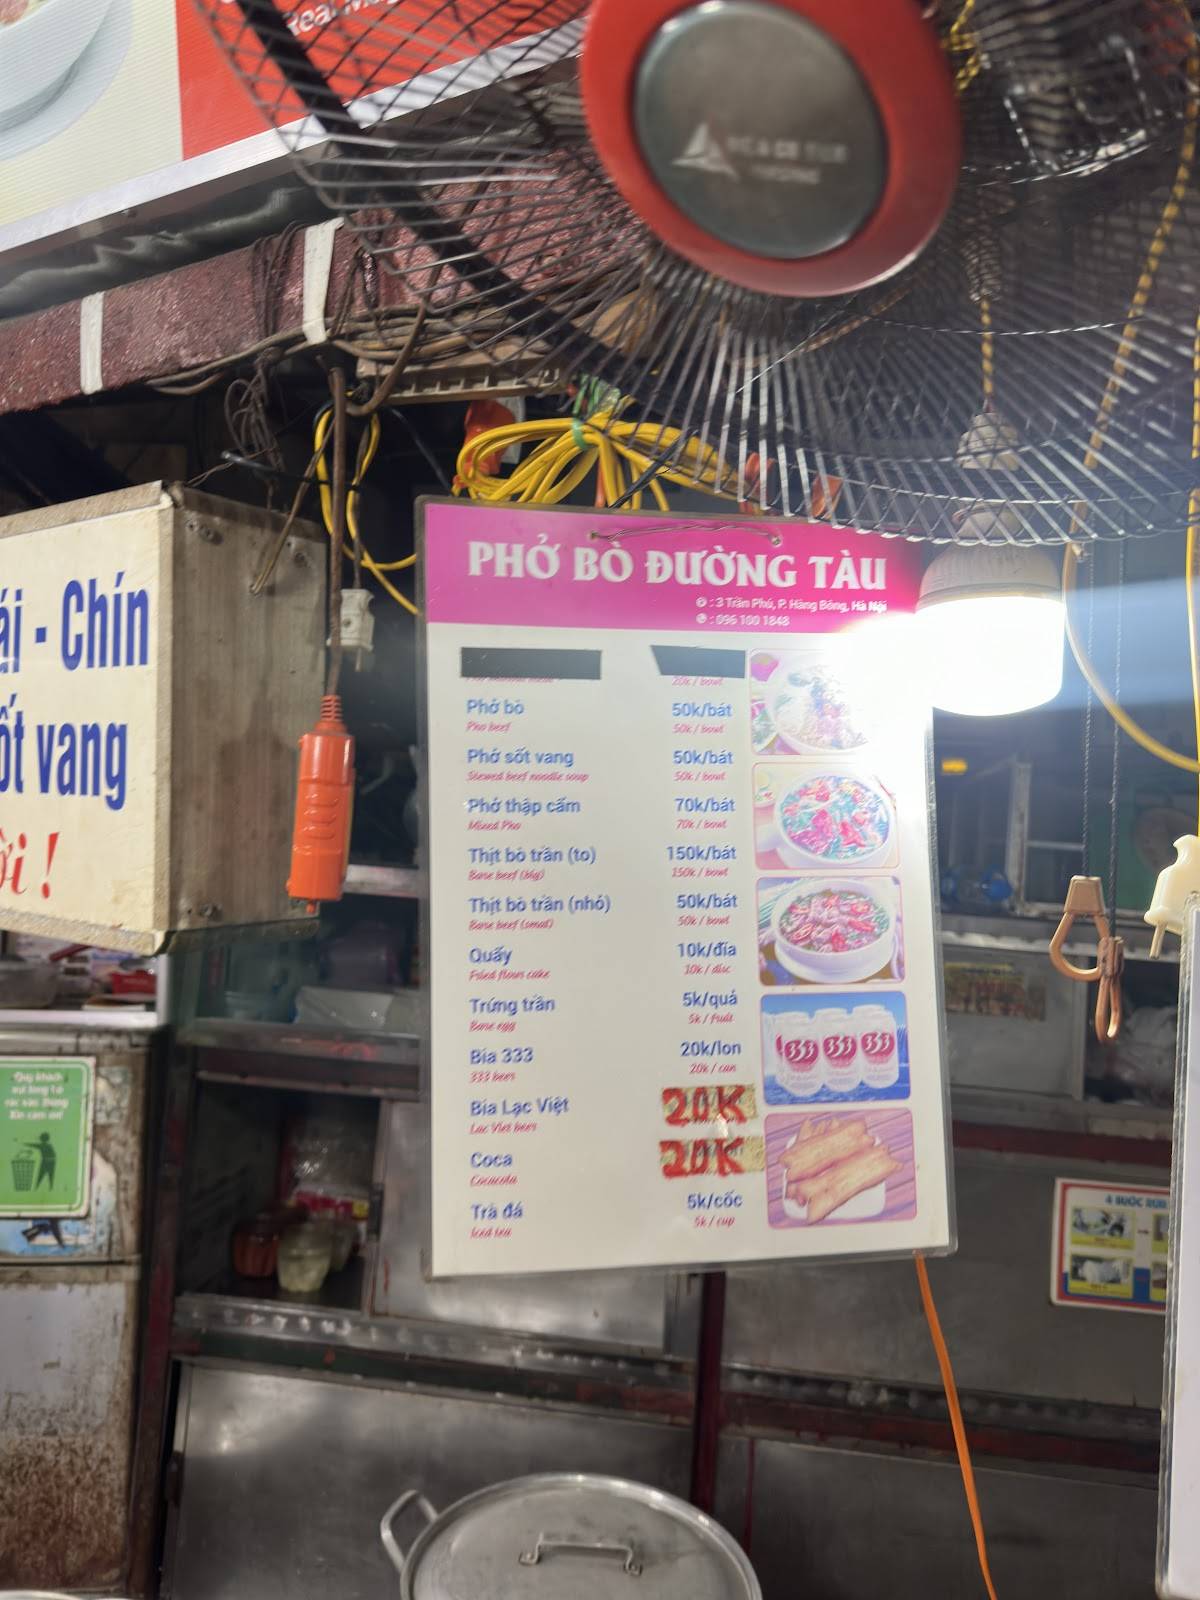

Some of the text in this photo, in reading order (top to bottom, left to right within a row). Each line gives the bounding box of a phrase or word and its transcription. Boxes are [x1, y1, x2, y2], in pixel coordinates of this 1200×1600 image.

[468, 534, 887, 591] PHỞ BÒ ĐƯỜNG TÀU
[716, 597, 724, 607] 3
[62, 571, 150, 671] Chín
[466, 699, 524, 714] Phở bò
[672, 702, 732, 718] 50k/bát
[672, 724, 691, 734] 50k
[467, 747, 574, 767] Phở sốt vang
[673, 750, 734, 766] 50k/bát
[37, 723, 128, 811] vang
[467, 798, 500, 813] Phở
[505, 798, 542, 815] thập
[674, 797, 736, 813] 70k/bát
[676, 820, 695, 830] 70k
[468, 846, 597, 866] Thịt bò trần (to)
[666, 845, 737, 861] 150k/bát
[671, 867, 696, 878] 150k
[468, 896, 501, 916] Thịt
[505, 896, 527, 912] bò
[530, 894, 564, 912] trần
[676, 893, 738, 910] 50k/bát
[678, 915, 696, 926] 50k
[469, 945, 513, 966] Quẩy
[684, 964, 703, 975] 10k
[469, 994, 556, 1016] Trứng trần
[682, 988, 738, 1009] 5k/quả
[470, 1047, 534, 1064] Bia 333
[680, 1040, 742, 1057] 20k/lon
[470, 1071, 491, 1083] 333
[690, 1062, 709, 1075] 20k
[471, 1096, 570, 1118] Bia Lạc Việt
[662, 1084, 747, 1126] 20K
[471, 1152, 513, 1168] Coca
[659, 1136, 745, 1179] 20K
[687, 1189, 743, 1210] 5k/cốc
[471, 1201, 524, 1220] Trà đá
